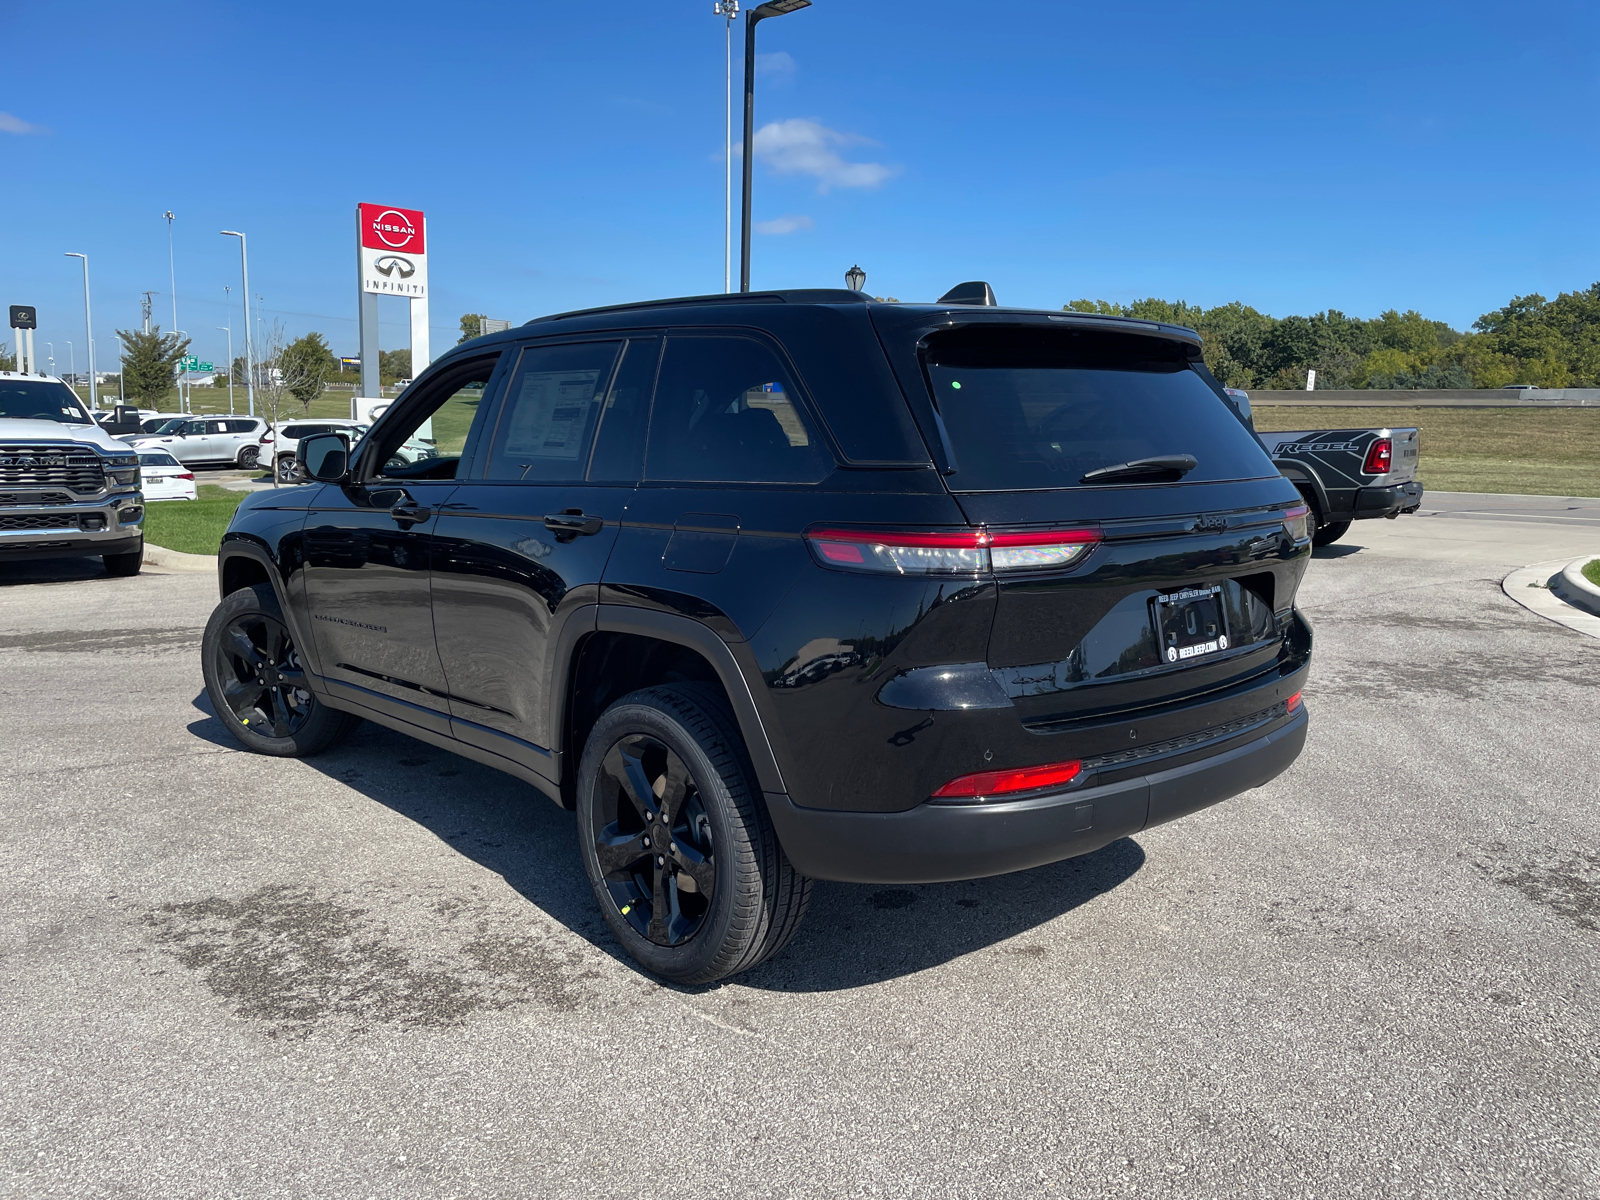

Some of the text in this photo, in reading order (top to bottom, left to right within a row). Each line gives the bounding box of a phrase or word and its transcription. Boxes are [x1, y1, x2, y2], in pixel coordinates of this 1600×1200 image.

[373, 222, 415, 235] NISSAN
[366, 279, 425, 294] INFINITI
[1272, 442, 1360, 454] REBEL
[1194, 514, 1228, 535] Jeep
[1170, 593, 1179, 601] JEEP
[1179, 589, 1199, 600] CHRYSLER
[1211, 585, 1221, 594] RAM
[1179, 641, 1218, 659] REEDJEEP.COM
